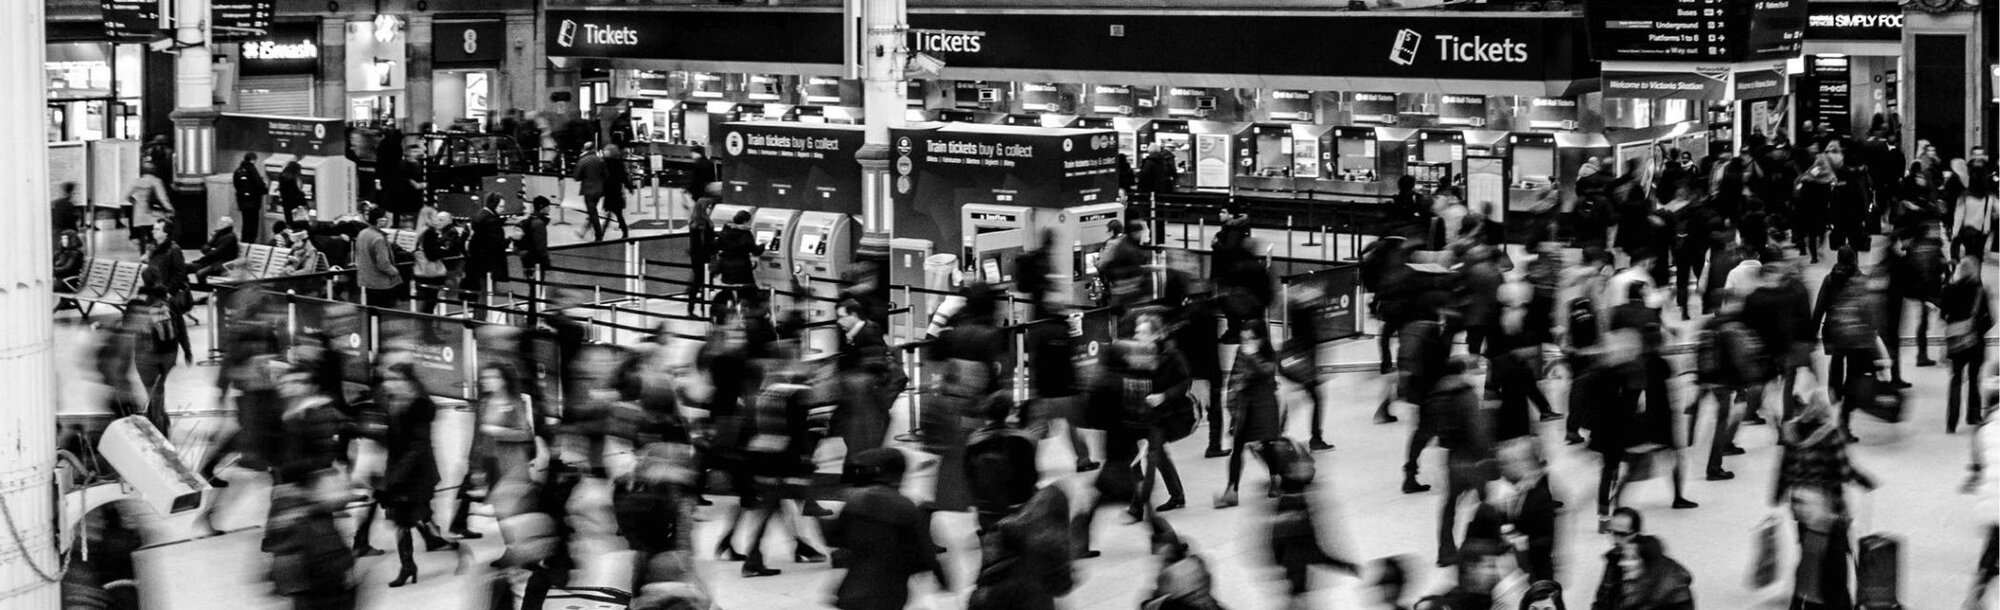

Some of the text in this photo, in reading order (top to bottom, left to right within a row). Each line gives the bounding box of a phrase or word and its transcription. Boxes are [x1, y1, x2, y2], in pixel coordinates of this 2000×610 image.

[1656, 21, 1699, 30] Underground
[1835, 14, 1877, 27] SIMPLY
[1878, 14, 1904, 27] FOO
[583, 23, 638, 45] Tickets
[914, 30, 981, 53] Tickets
[1648, 34, 1680, 42] Platforms
[1685, 34, 1693, 42] to
[1693, 34, 1699, 42] 8
[260, 39, 317, 59] iSmash
[1435, 35, 1528, 62] Tickets
[1671, 47, 1686, 55] Way
[1609, 80, 1704, 90] Welcome to Victoria Station
[747, 133, 839, 151] Train tickets buy & collect
[926, 139, 1033, 158] Train tickets buy & collect
